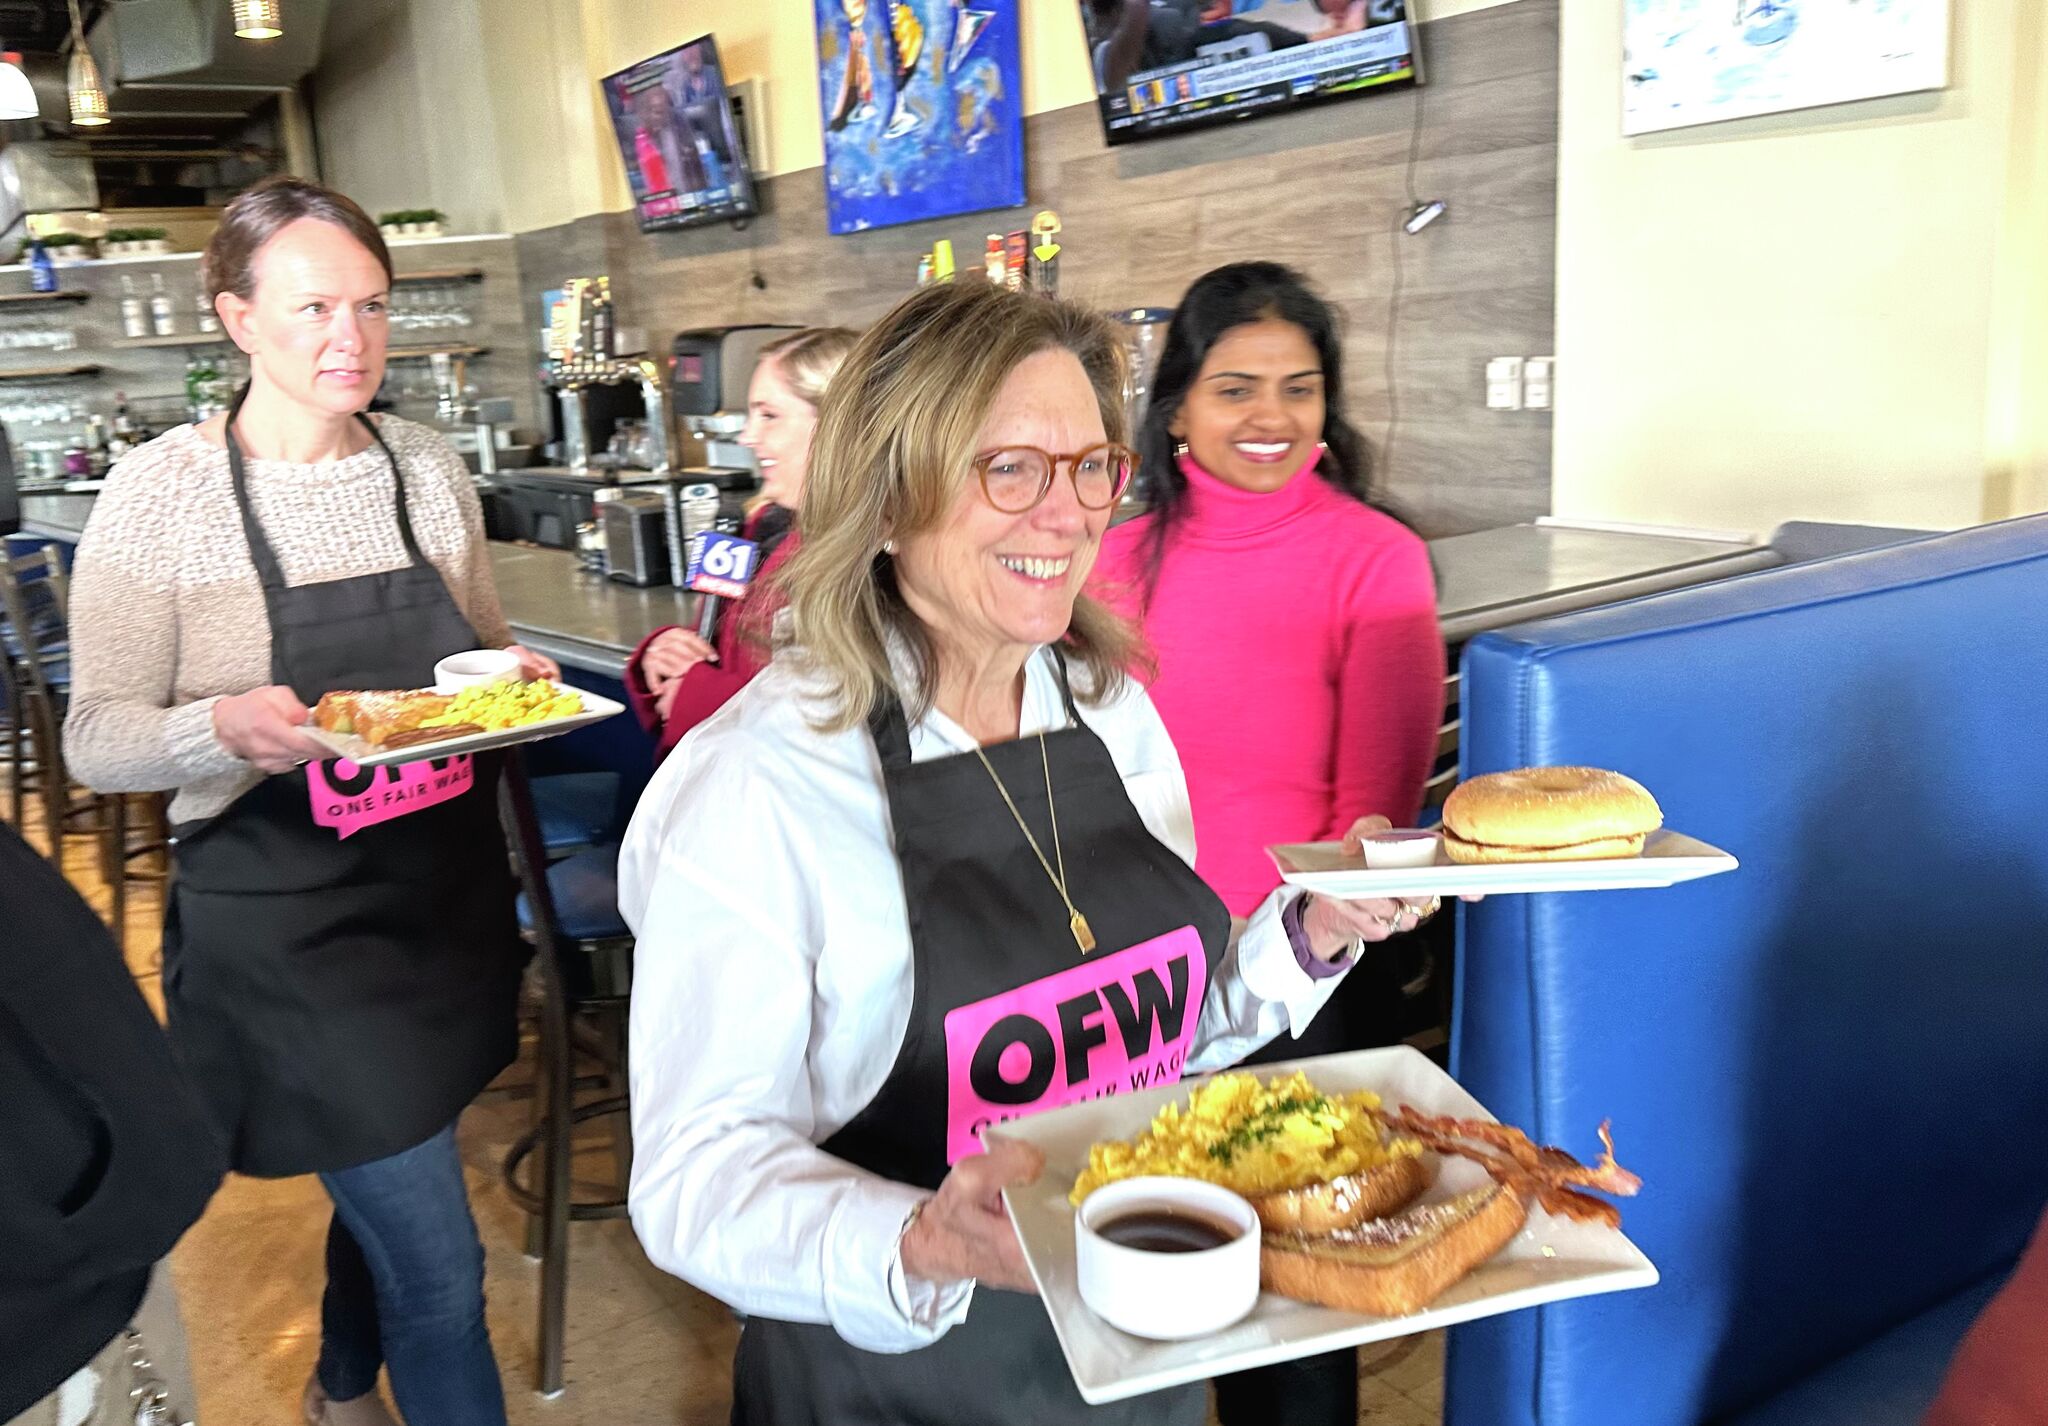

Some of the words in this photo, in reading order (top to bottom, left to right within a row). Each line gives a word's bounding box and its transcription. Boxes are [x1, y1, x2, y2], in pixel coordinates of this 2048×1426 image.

[703, 540, 753, 580] 61
[327, 797, 375, 816] ONE
[383, 783, 428, 806] FAIR
[970, 955, 1189, 1105] OFW
[1130, 1041, 1189, 1093] WAG
